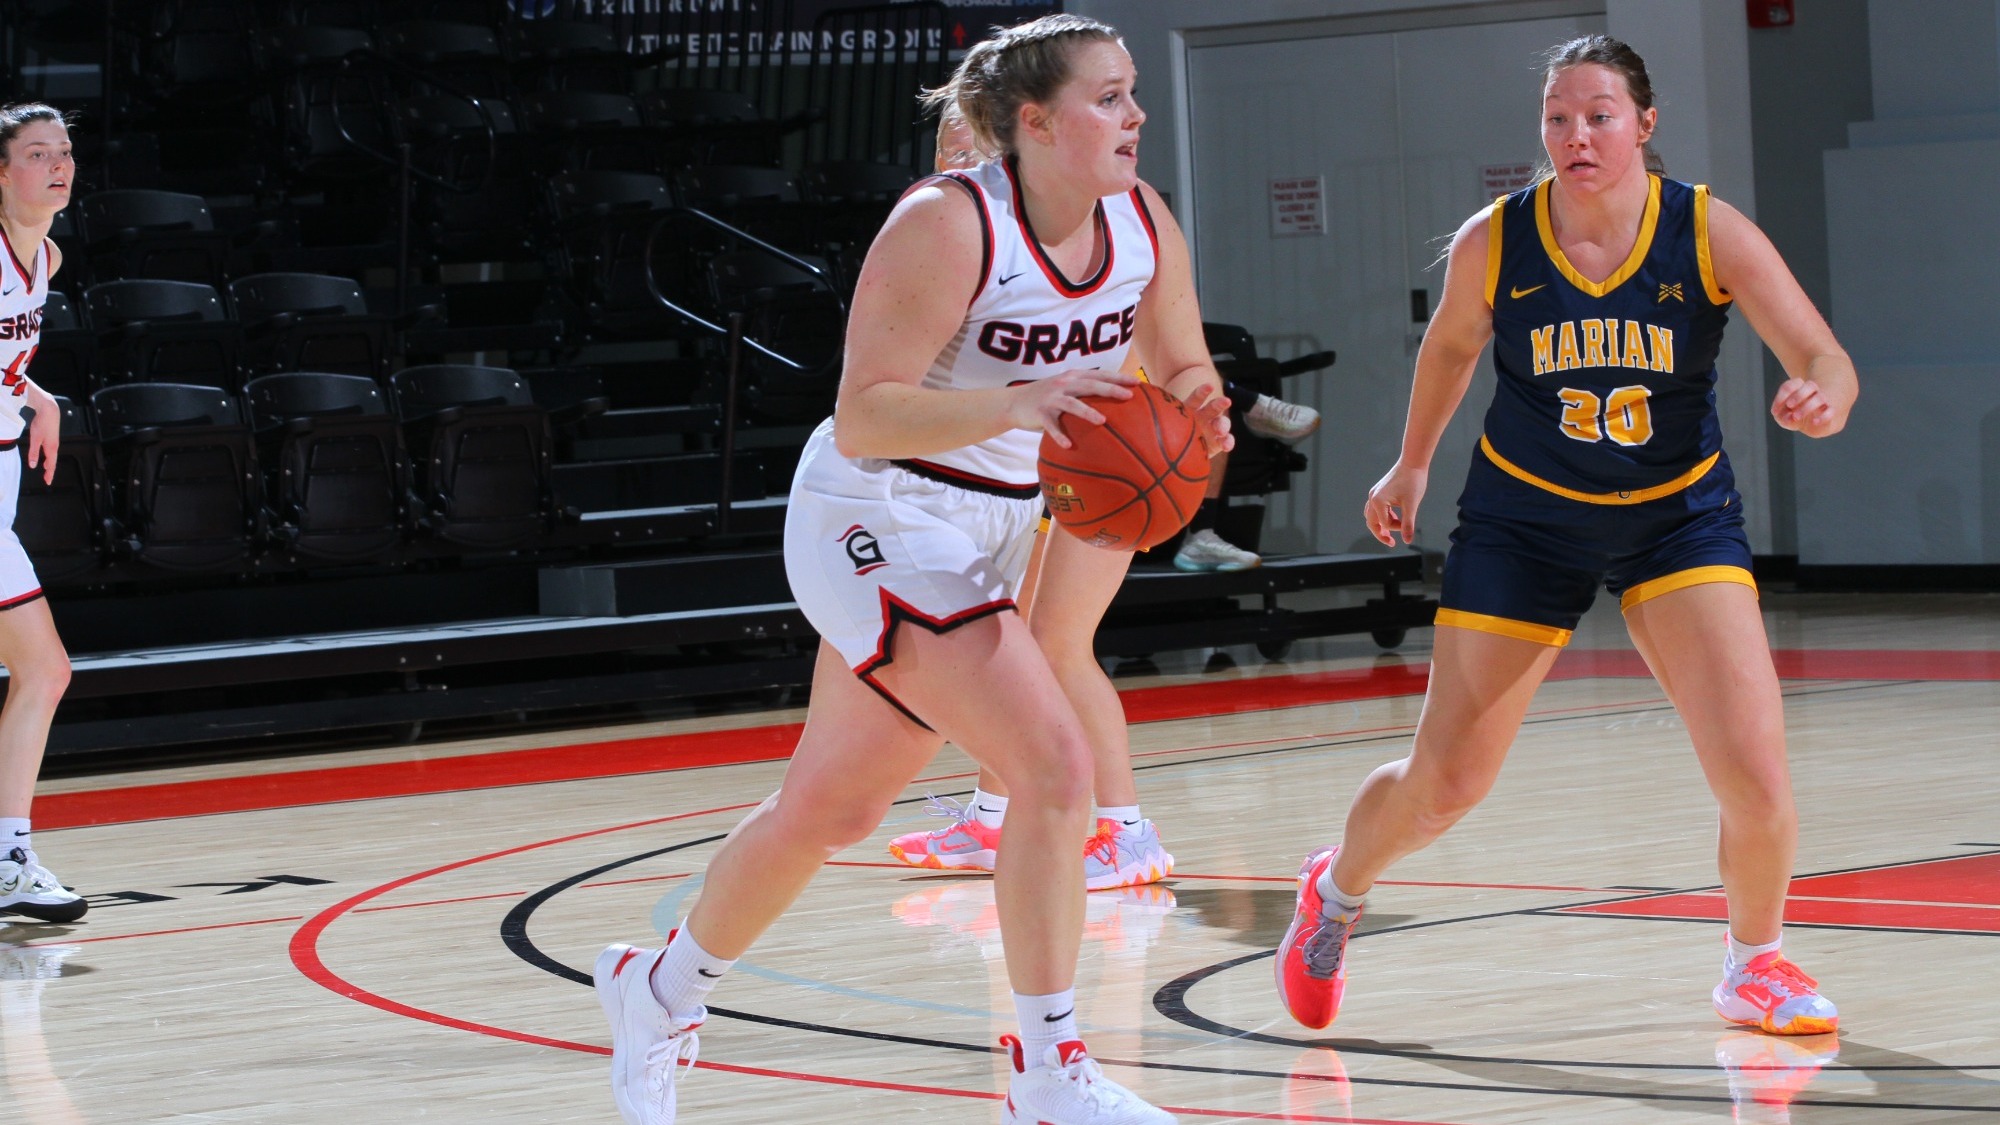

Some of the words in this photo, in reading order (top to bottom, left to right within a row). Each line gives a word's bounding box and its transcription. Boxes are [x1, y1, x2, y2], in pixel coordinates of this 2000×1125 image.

[749, 31, 855, 51] TAINNG
[977, 304, 1136, 366] GRACE
[1530, 318, 1674, 376] MARIAN
[1556, 384, 1654, 447] 30
